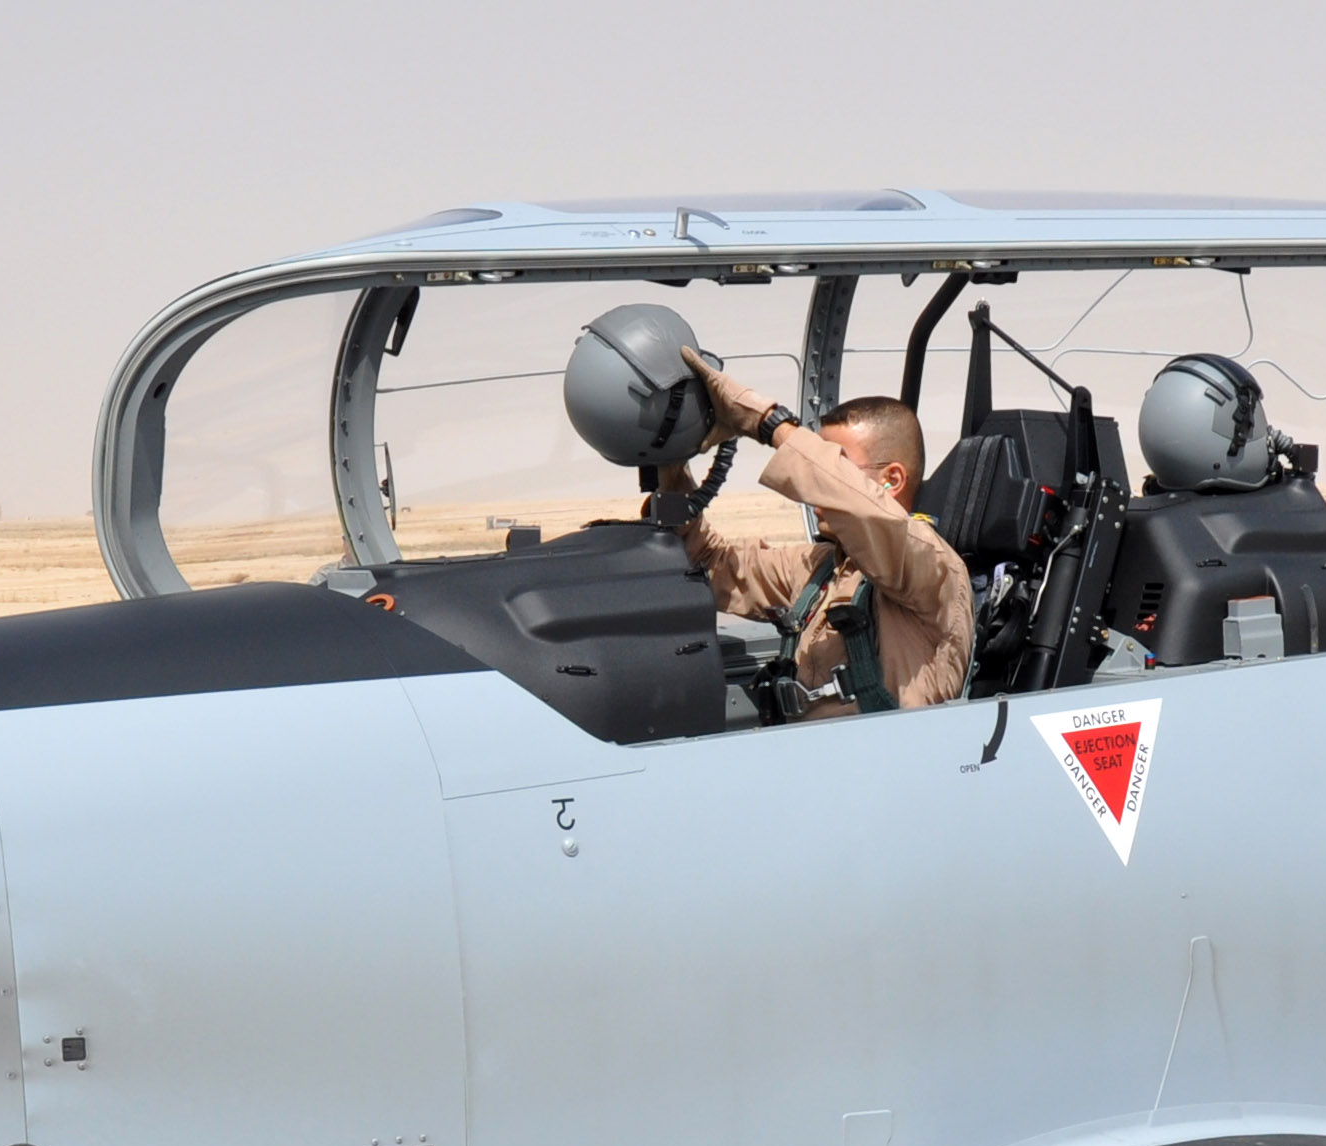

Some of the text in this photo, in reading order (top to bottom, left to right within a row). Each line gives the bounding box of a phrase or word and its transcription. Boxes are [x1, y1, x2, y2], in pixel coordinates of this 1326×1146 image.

[1073, 709, 1126, 729] DANGER
[1075, 733, 1136, 755] EJECTION
[959, 763, 980, 774] OPEN
[1093, 754, 1123, 771] SEAT
[1063, 753, 1107, 818] DANGER
[1127, 743, 1149, 812] DANGER
